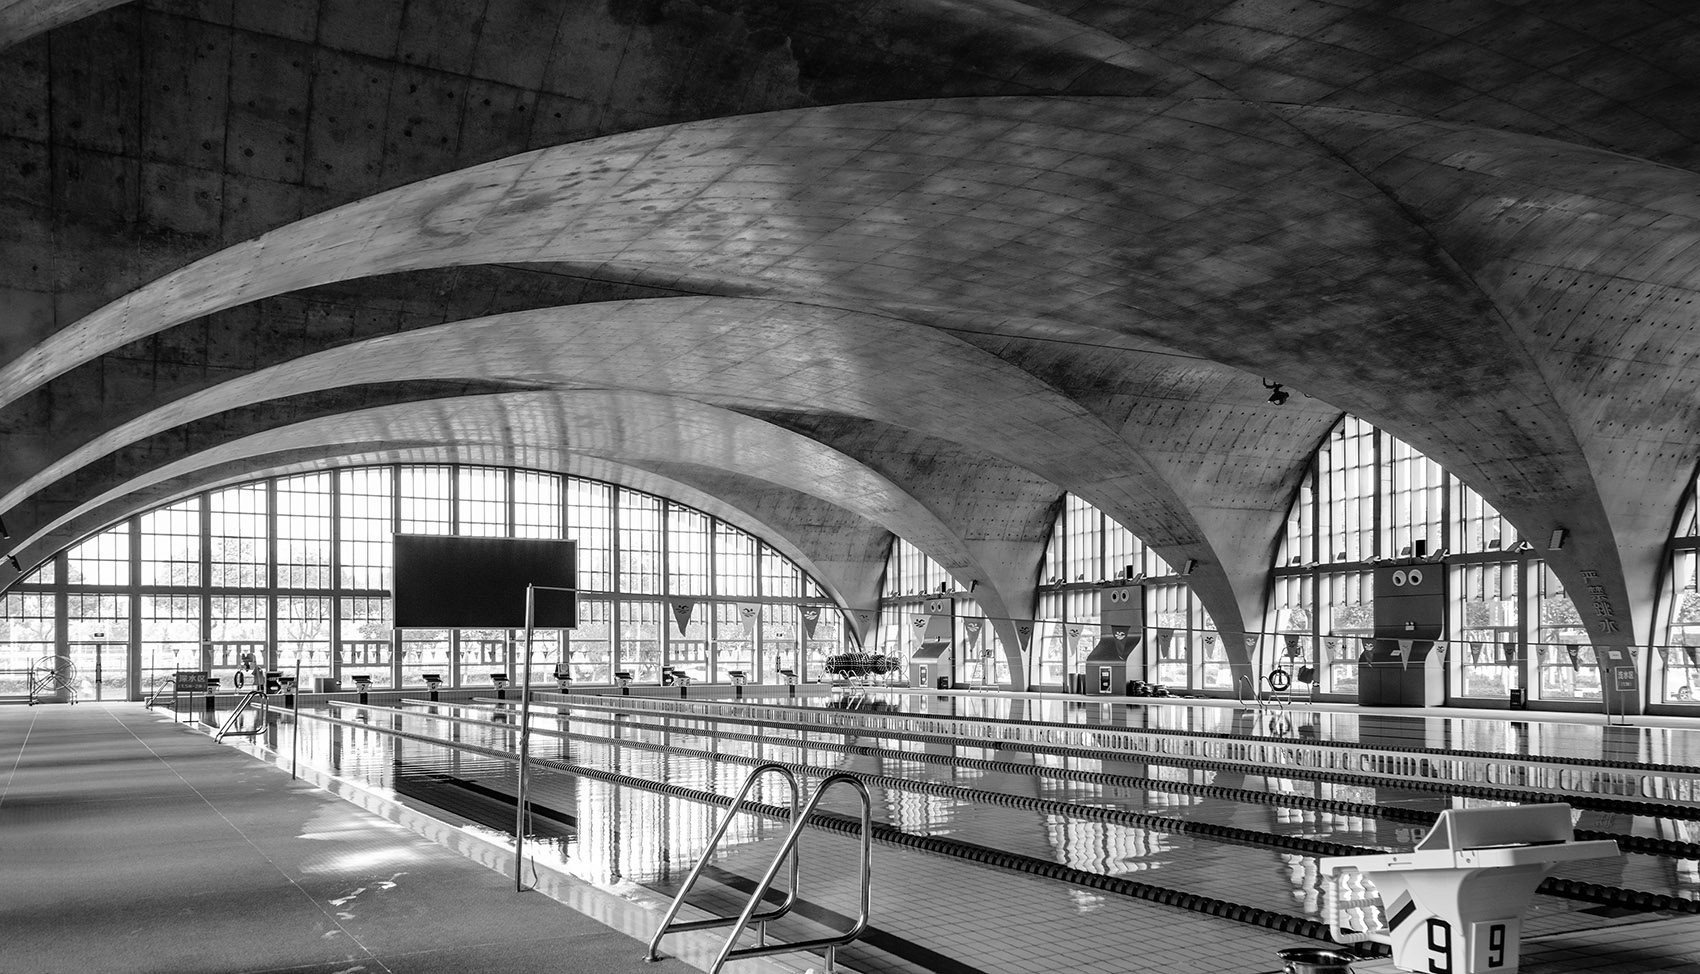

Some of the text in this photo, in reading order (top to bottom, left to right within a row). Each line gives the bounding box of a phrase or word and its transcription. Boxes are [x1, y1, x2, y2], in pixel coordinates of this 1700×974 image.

[1580, 570, 1619, 633] 严禁跳水
[1426, 918, 1452, 974] 9
[1488, 924, 1505, 968] 9
